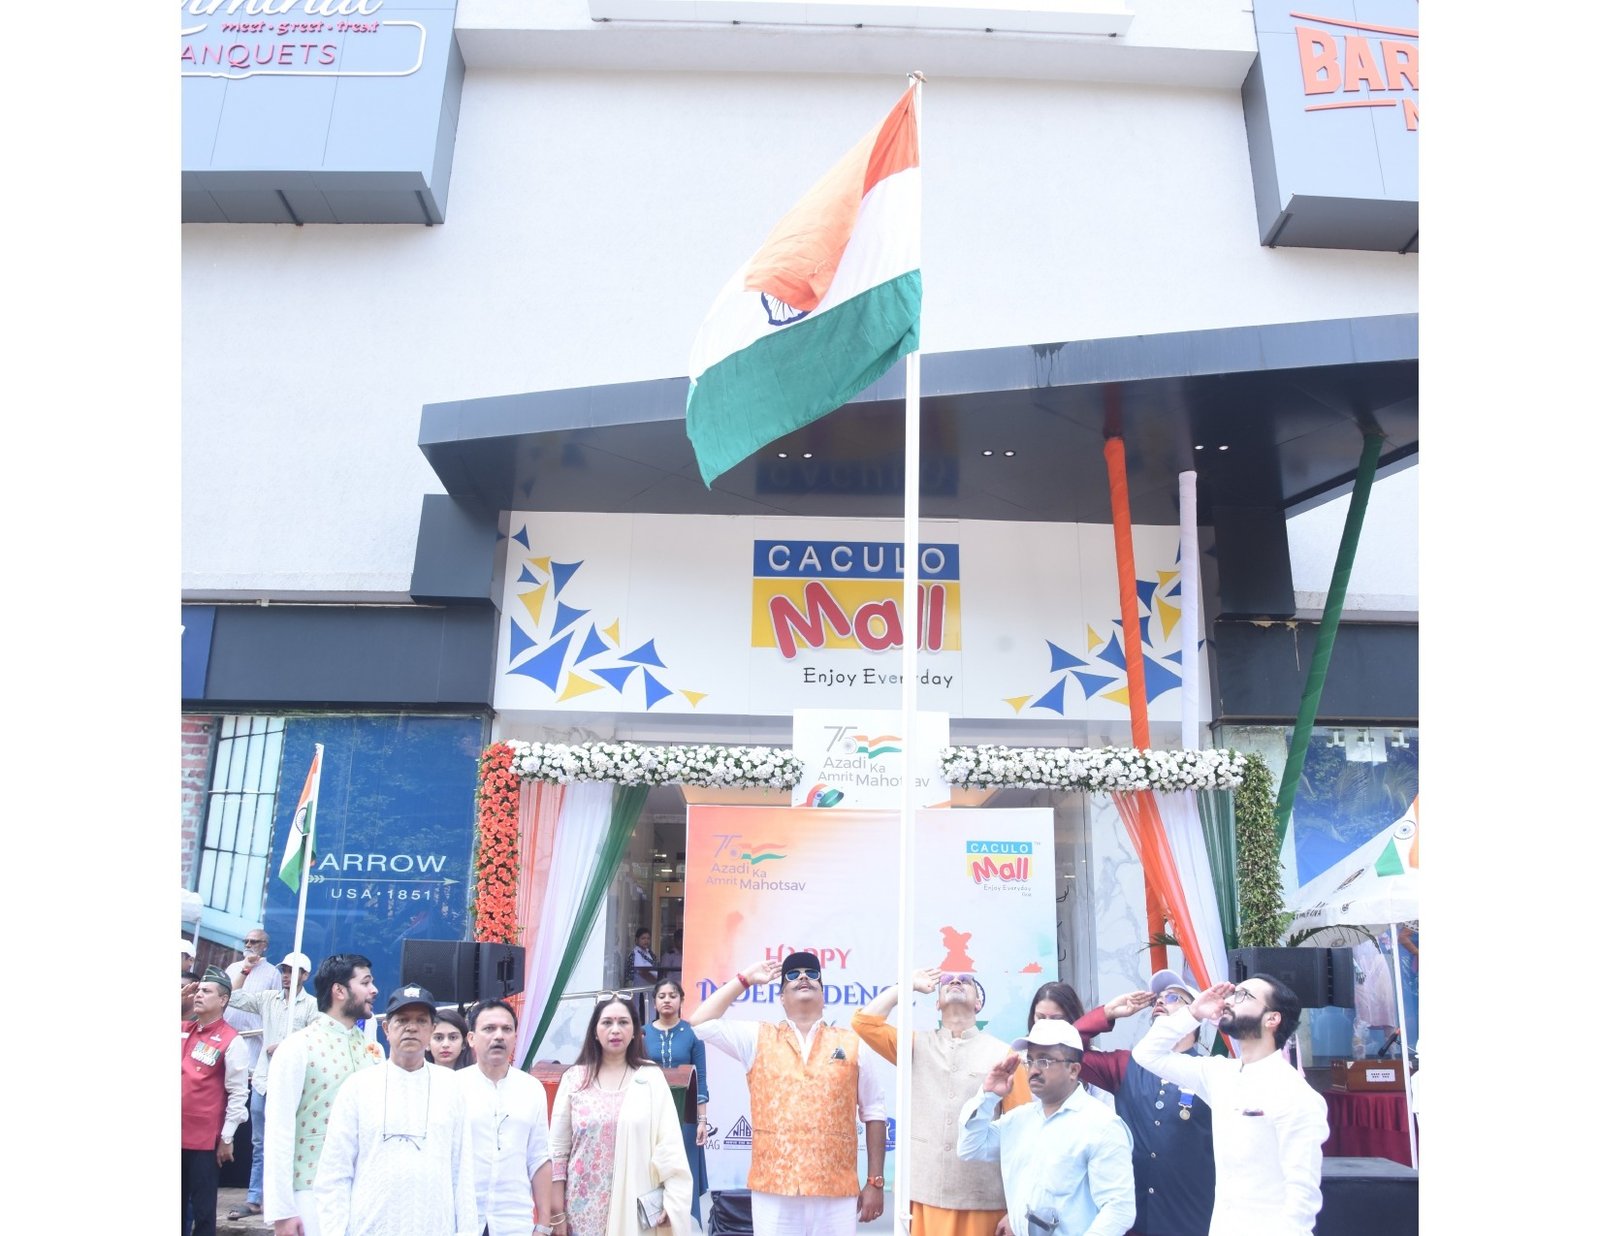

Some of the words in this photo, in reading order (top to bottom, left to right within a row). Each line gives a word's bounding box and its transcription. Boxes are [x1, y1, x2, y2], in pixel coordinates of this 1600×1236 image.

[221, 21, 266, 33] meet
[277, 21, 325, 36] greet
[337, 20, 380, 33] treat
[768, 545, 945, 574] CACULO
[803, 667, 857, 687] Enjoy
[863, 668, 953, 689] Eveday
[823, 756, 866, 769] Azadi
[870, 763, 886, 773] Ka
[818, 771, 854, 782] Amrit
[856, 774, 930, 787] Mahoav
[970, 843, 1029, 854] CACULO
[318, 853, 447, 873] ARROW
[711, 863, 750, 874] Azadi
[752, 869, 767, 879] Ka
[971, 856, 1029, 884] Mall
[706, 876, 738, 886] Amrit
[740, 879, 807, 891] Mahotsav
